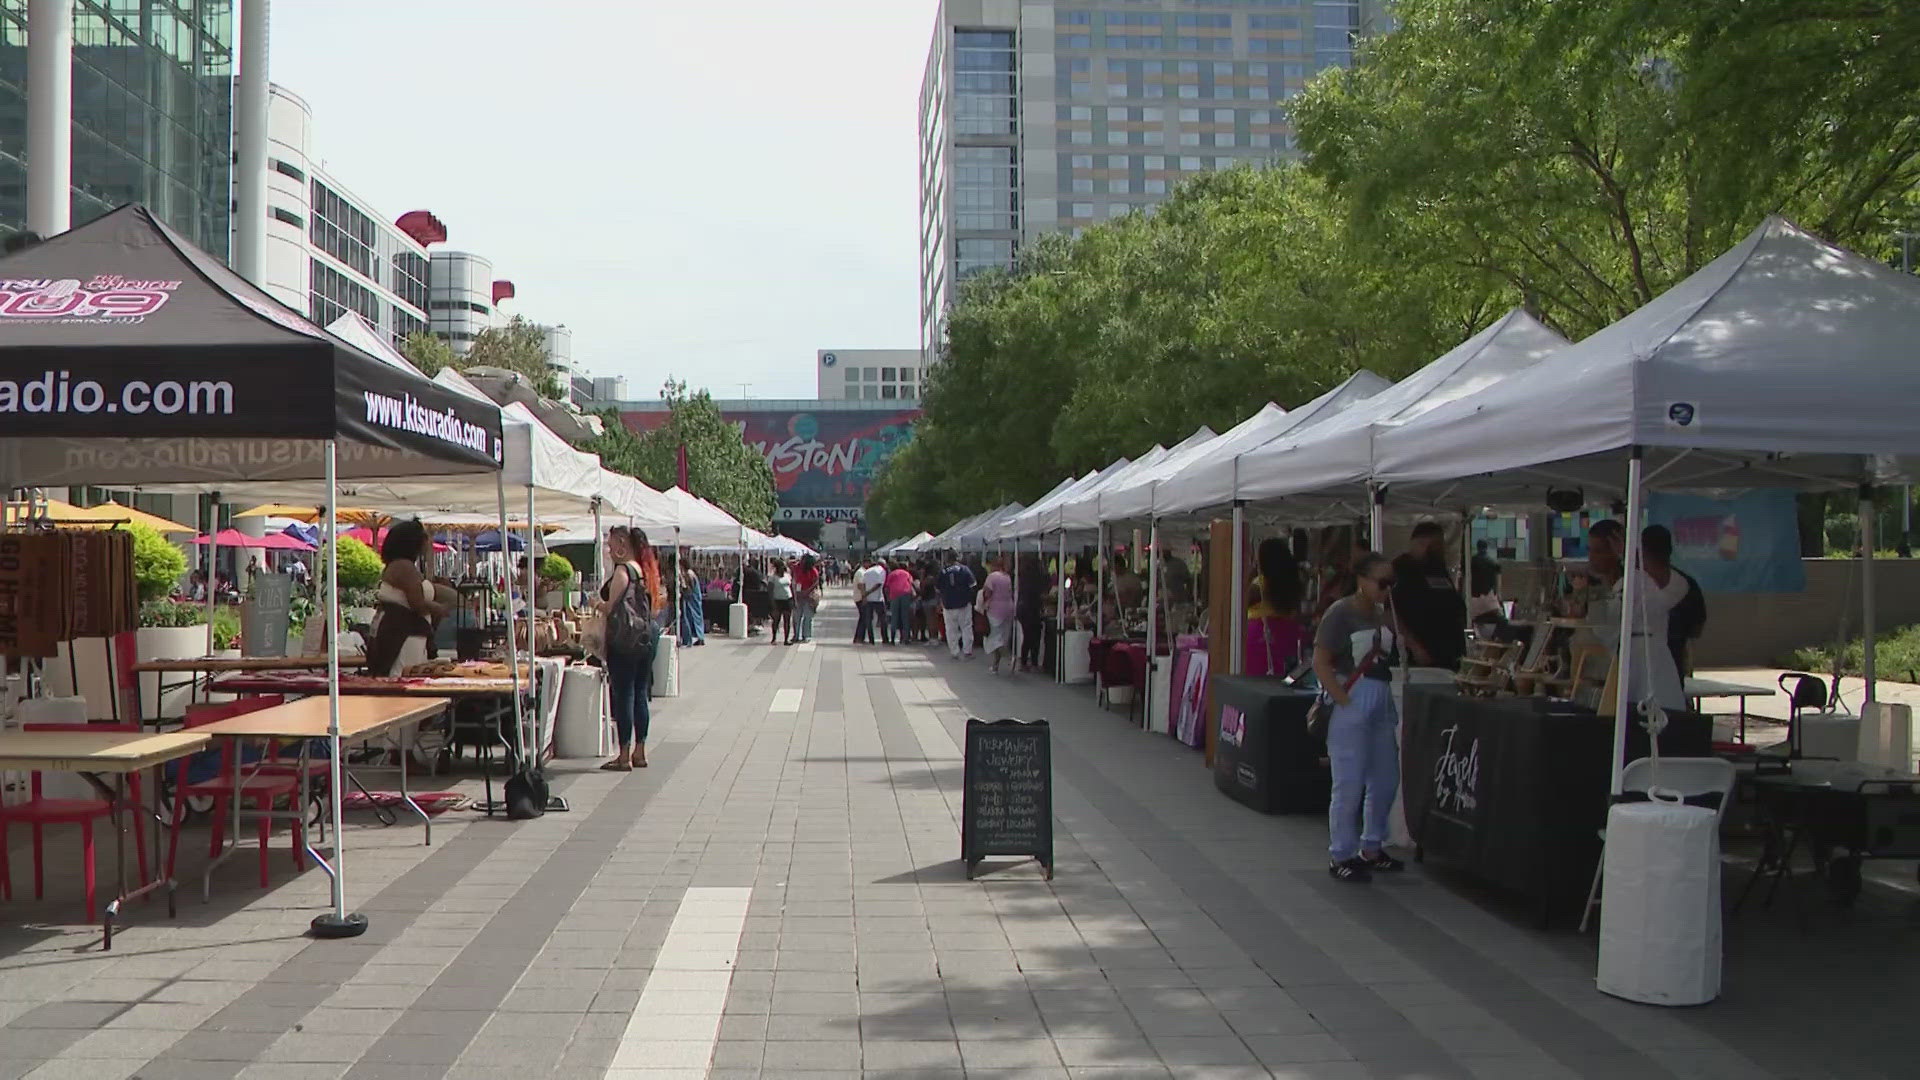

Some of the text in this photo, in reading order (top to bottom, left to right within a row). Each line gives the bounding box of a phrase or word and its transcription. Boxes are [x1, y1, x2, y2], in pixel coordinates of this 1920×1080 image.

[0, 370, 234, 414] adio.com
[364, 390, 487, 453] www.ktsuradio.com
[801, 509, 858, 520] PARKING
